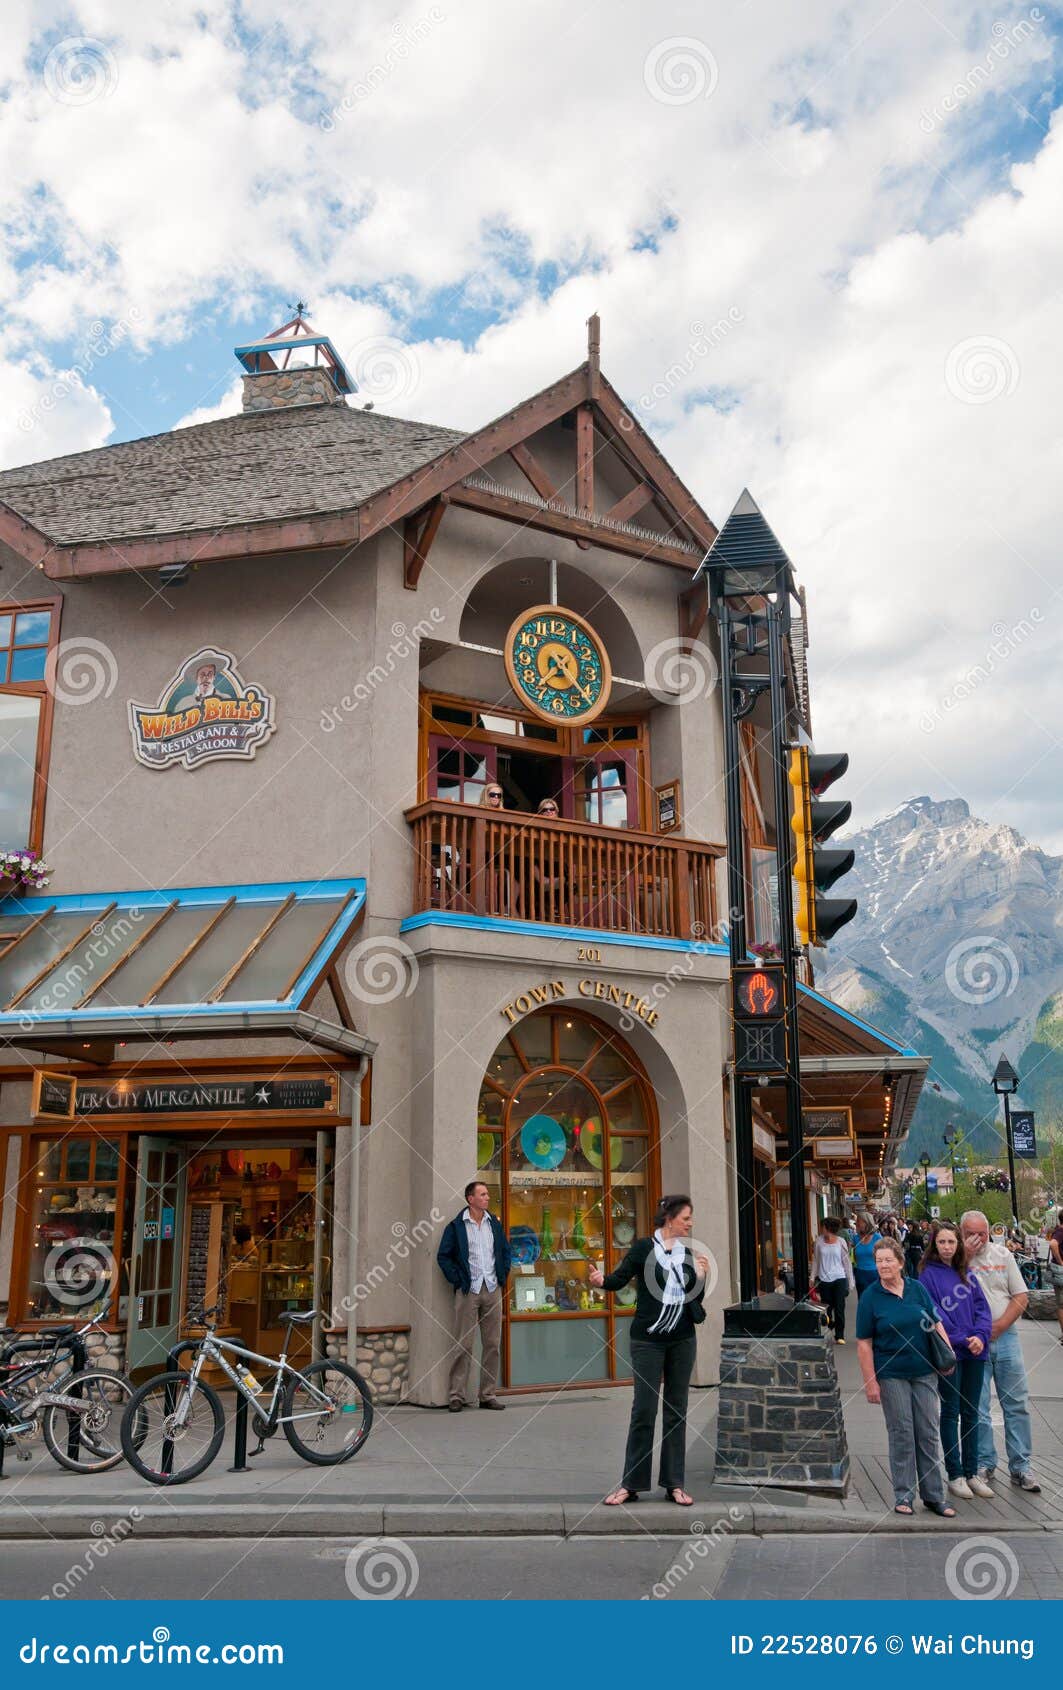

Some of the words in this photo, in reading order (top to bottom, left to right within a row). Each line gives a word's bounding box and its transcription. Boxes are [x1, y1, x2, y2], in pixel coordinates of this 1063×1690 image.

[536, 621, 547, 636] 11
[551, 620, 566, 636] 12
[520, 632, 538, 648] 10
[571, 630, 577, 644] 1
[519, 651, 531, 666] 9
[581, 646, 592, 661] 2
[523, 669, 535, 684] 8
[585, 666, 596, 681] 3
[536, 685, 547, 700] 7
[581, 684, 593, 699] 4
[552, 698, 564, 713] 6
[570, 694, 581, 708] 5
[139, 709, 201, 740] WILD
[203, 692, 262, 722] BILL'S
[161, 727, 228, 754] RESTAURANT
[230, 726, 239, 737] &
[196, 738, 237, 754] SALOON
[577, 948, 602, 962] 201
[501, 981, 566, 1025] TOWN
[578, 979, 662, 1029] CENTRE
[75, 1093, 100, 1109] VER
[106, 1091, 140, 1109] CITY
[144, 1088, 247, 1108] MERCANTILE
[144, 1223, 159, 1239] OPEN
